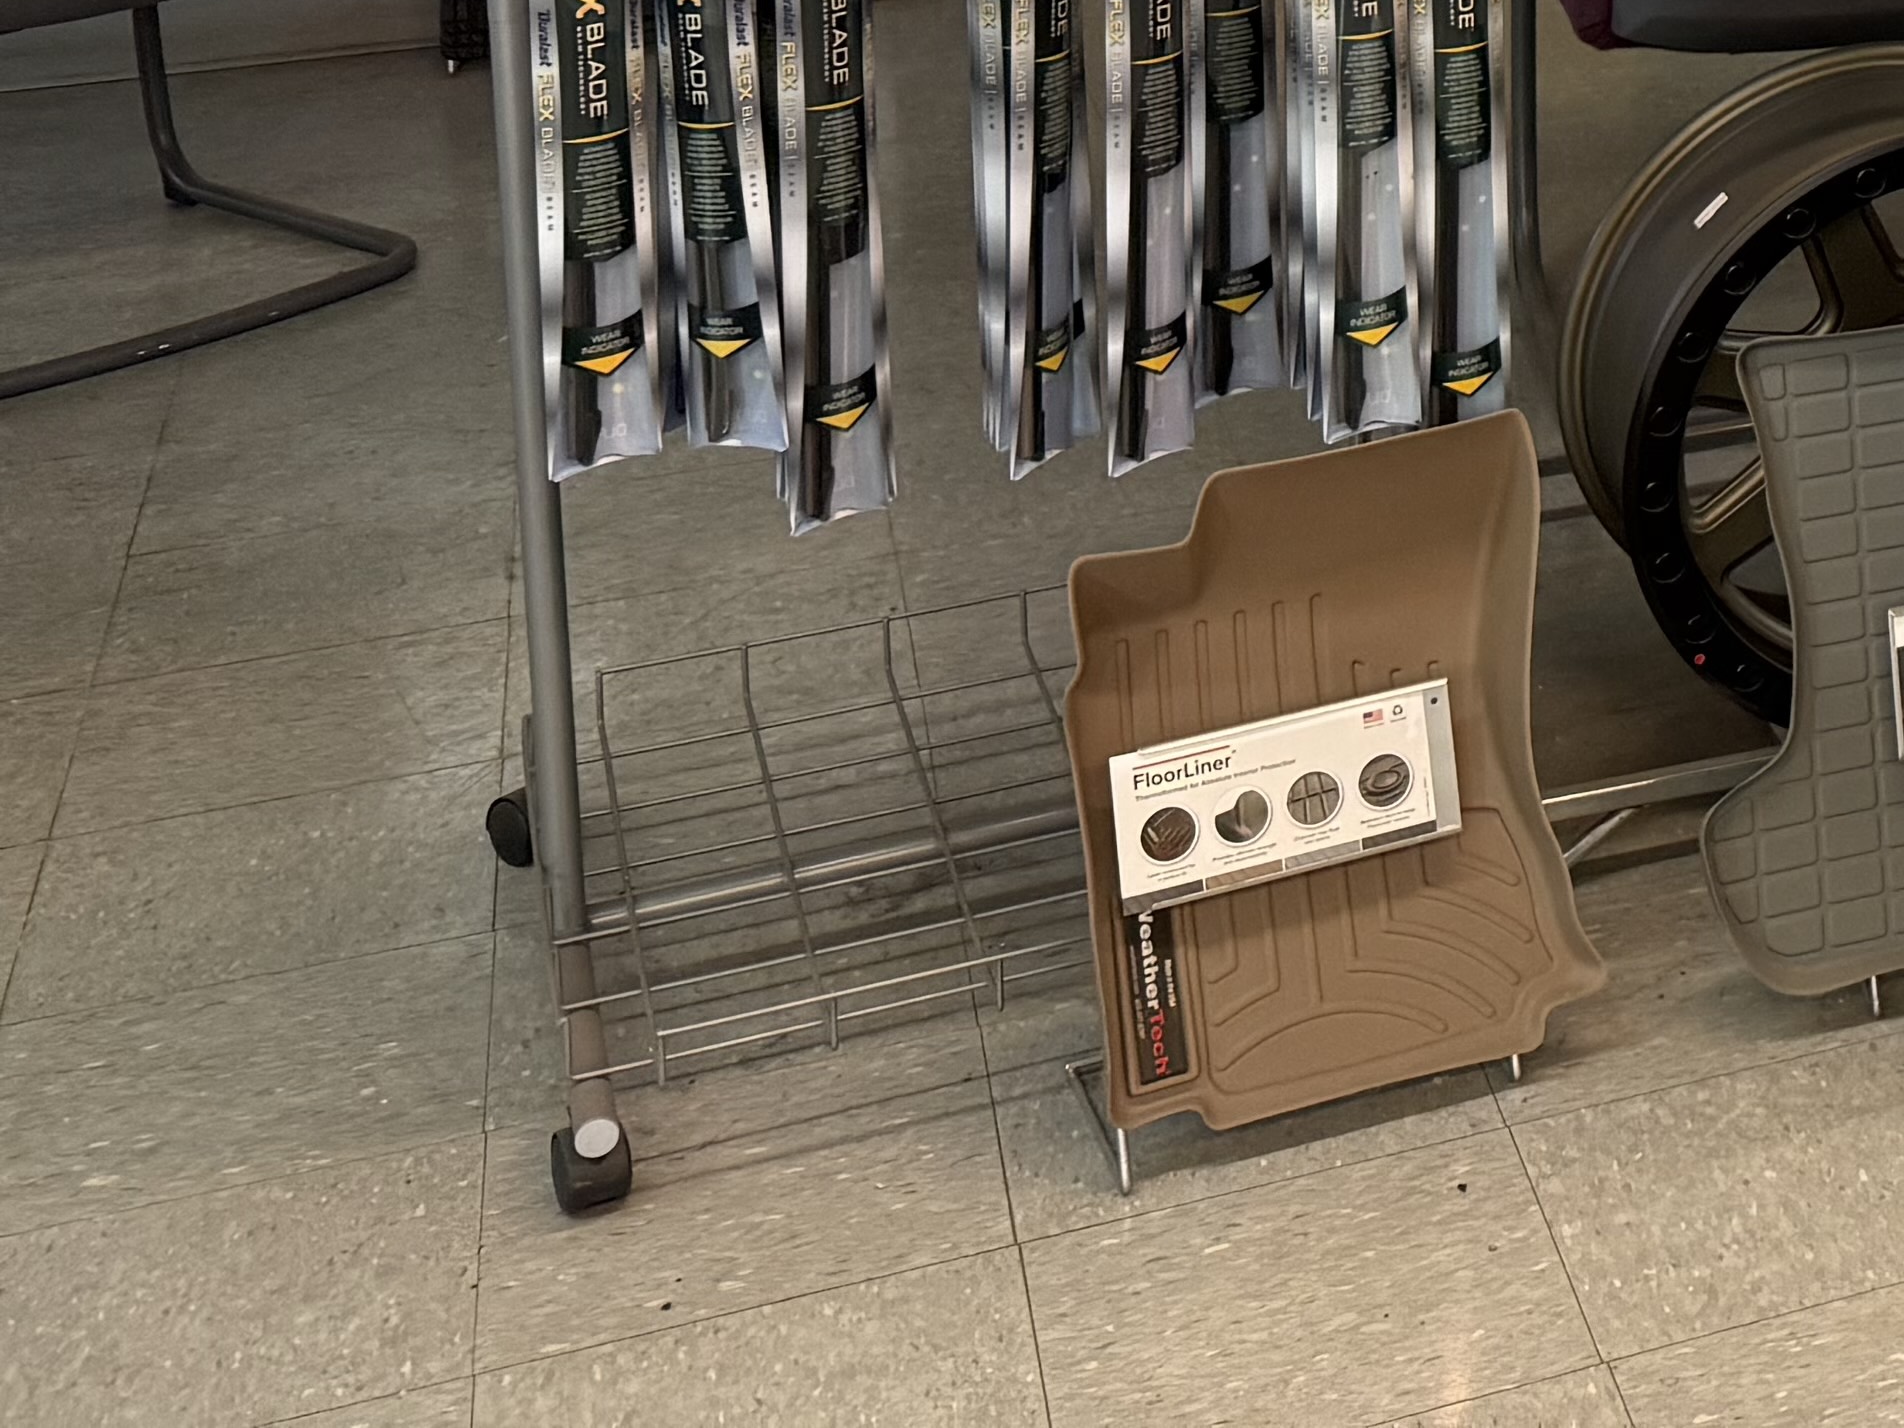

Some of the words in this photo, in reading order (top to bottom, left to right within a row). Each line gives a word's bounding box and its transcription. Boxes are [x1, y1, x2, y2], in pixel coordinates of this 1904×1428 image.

[585, 22, 608, 120] BLADE
[684, 12, 710, 108] BLADE
[1133, 755, 1232, 790] FloorLiner
